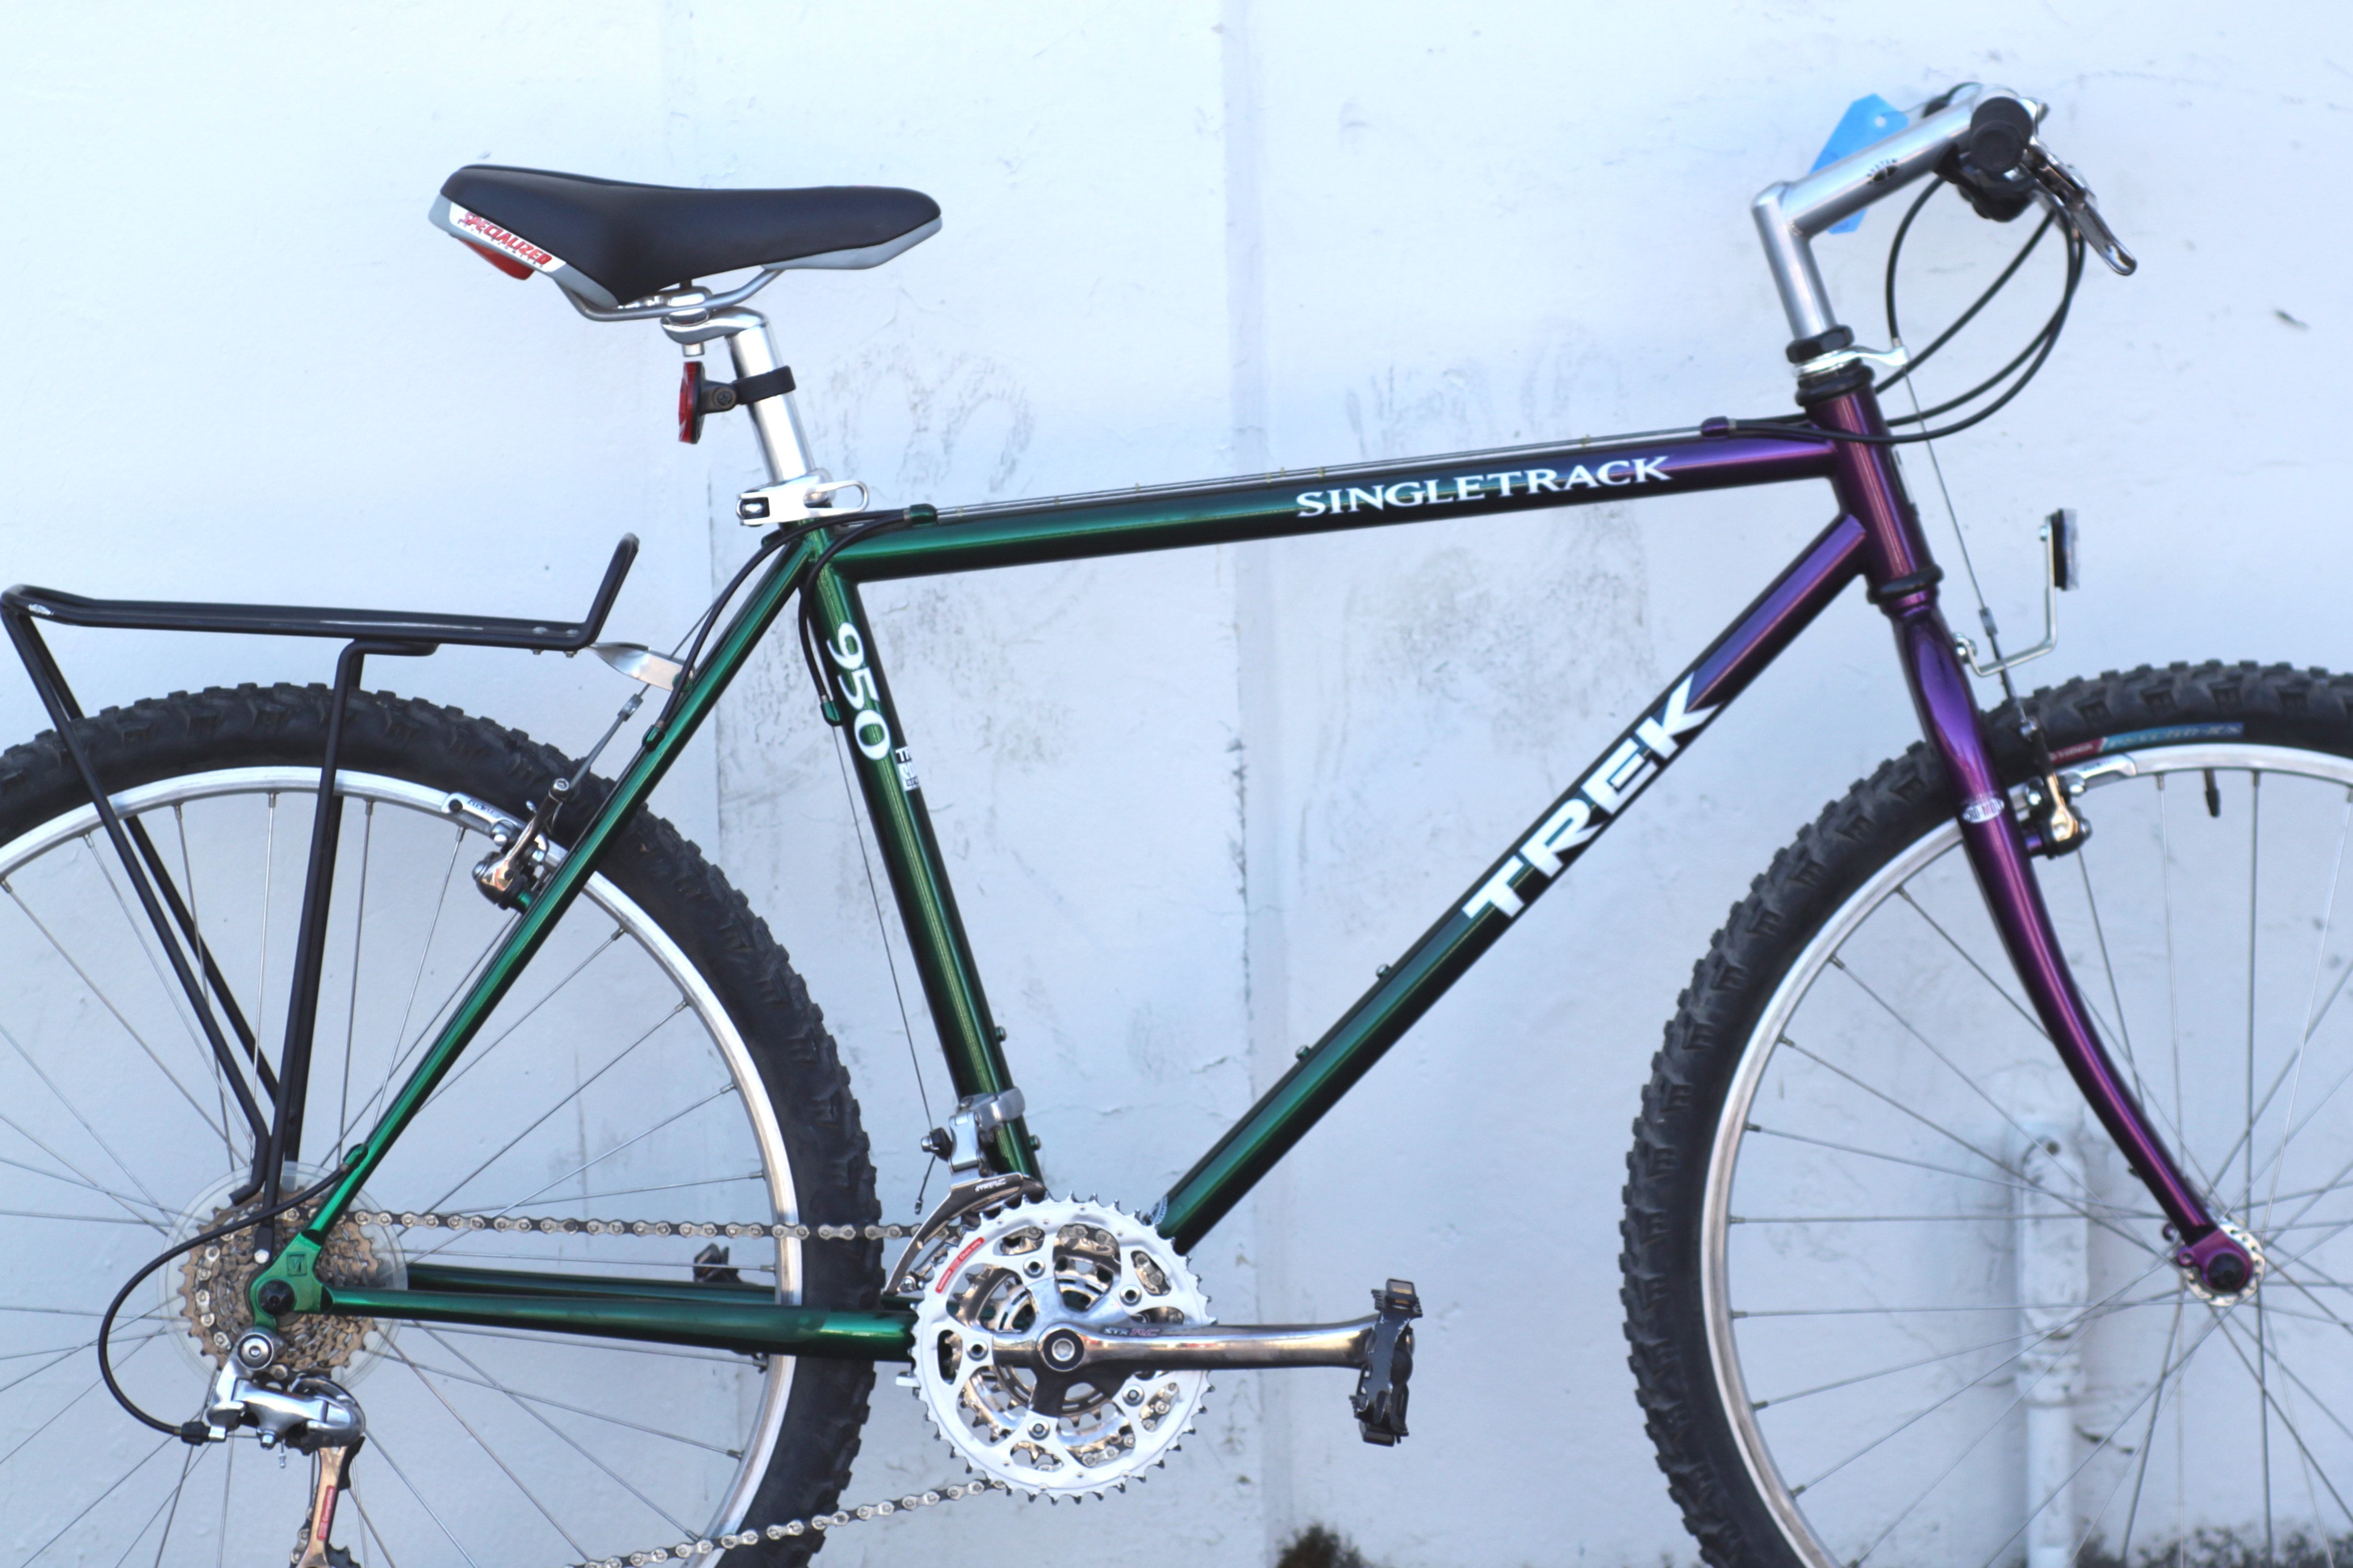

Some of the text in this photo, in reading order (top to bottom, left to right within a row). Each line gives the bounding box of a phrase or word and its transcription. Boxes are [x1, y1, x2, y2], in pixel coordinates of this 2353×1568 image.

[459, 212, 552, 265] SPECIALIZED
[1296, 456, 1674, 518] SINGLETRACK
[826, 622, 891, 760] 950
[1462, 671, 1721, 920] TREK
